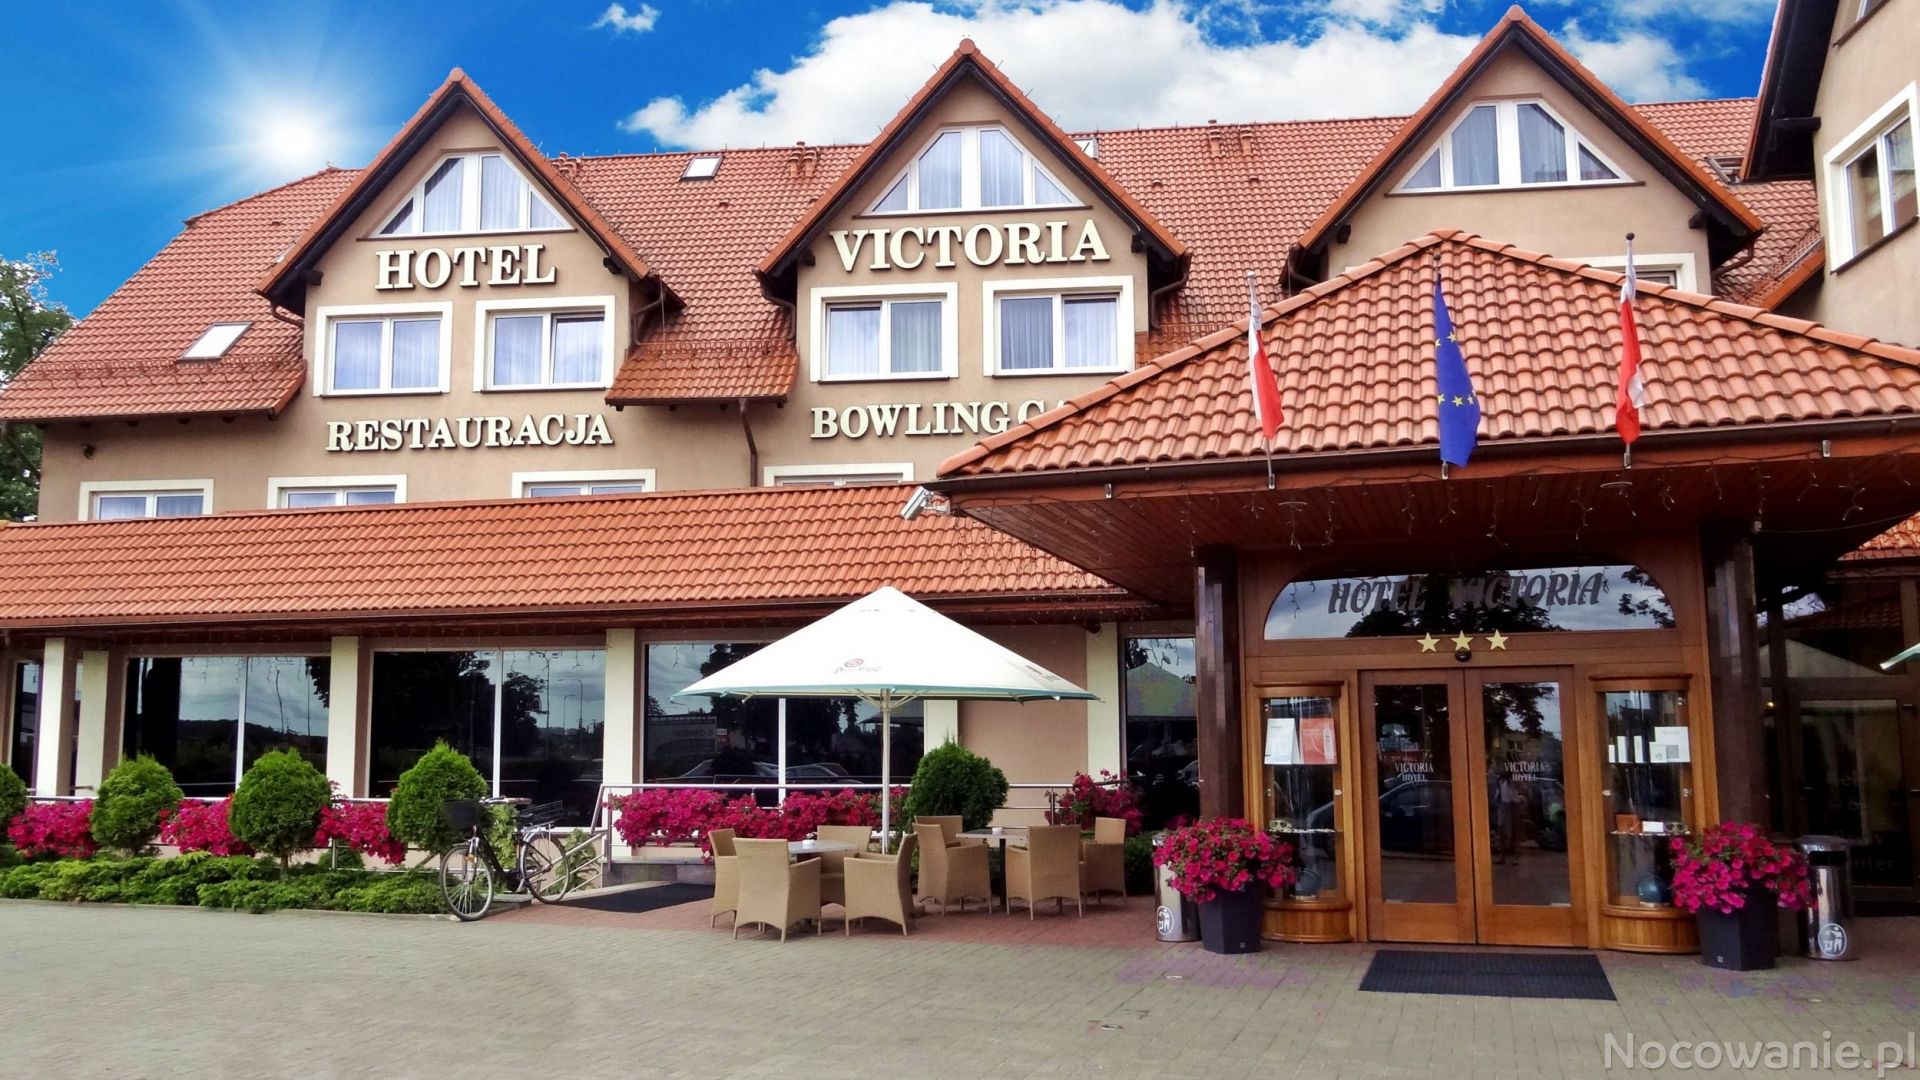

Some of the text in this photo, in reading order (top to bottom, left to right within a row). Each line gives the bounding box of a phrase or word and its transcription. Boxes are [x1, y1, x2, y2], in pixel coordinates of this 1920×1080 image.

[829, 219, 1111, 272] VICTORIA
[375, 244, 557, 290] HOTEL
[325, 413, 614, 451] RESTAURACJA
[810, 399, 1066, 439] BOWLING C
[1328, 572, 1603, 614] HOTEL VICTORIA
[1395, 762, 1435, 773] VICTORIA
[1402, 774, 1428, 783] HOTEL
[1503, 761, 1546, 773] VICTORIA
[1511, 773, 1538, 783] HOTEL
